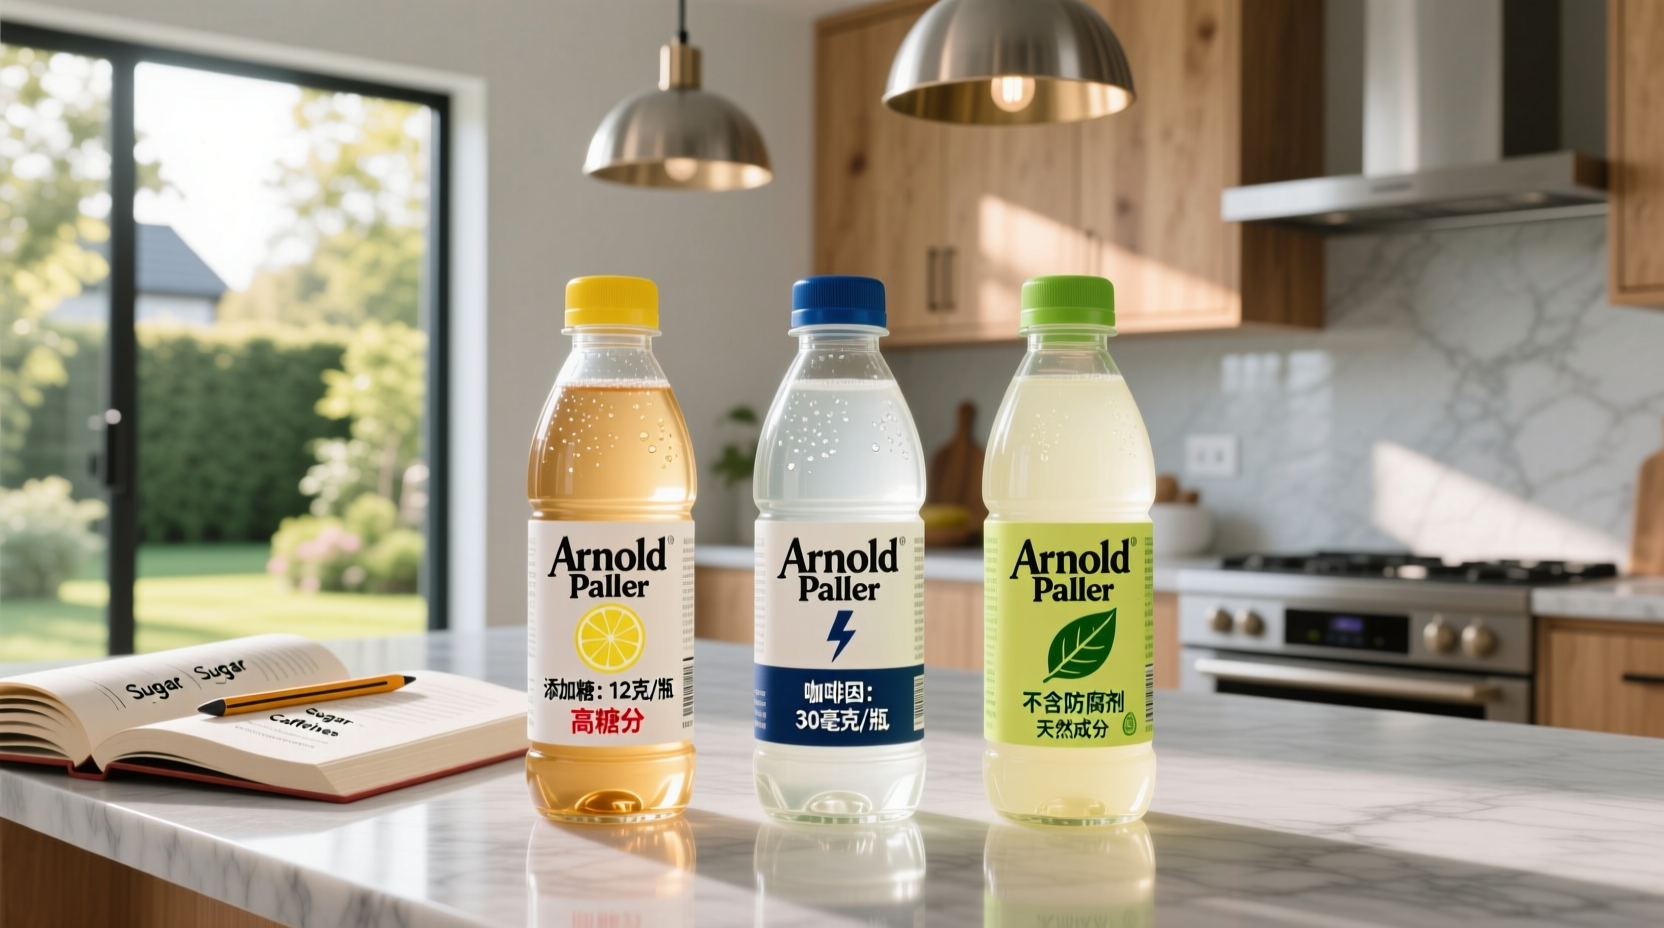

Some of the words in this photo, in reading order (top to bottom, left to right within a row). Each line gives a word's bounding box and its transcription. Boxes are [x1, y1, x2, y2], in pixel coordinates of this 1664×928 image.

[547, 535, 667, 577] Arnold
[777, 536, 899, 579] Arnold
[1009, 538, 1131, 580] Arnold
[569, 573, 650, 599] Paller
[798, 575, 881, 602] Paller
[1031, 576, 1115, 602] Paller
[125, 677, 183, 700] Sugar
[193, 659, 246, 680] Sugar
[1022, 689, 1125, 715] 不含防腐剂
[570, 706, 645, 735] 高糖分
[1036, 717, 1110, 740] 天然成分
